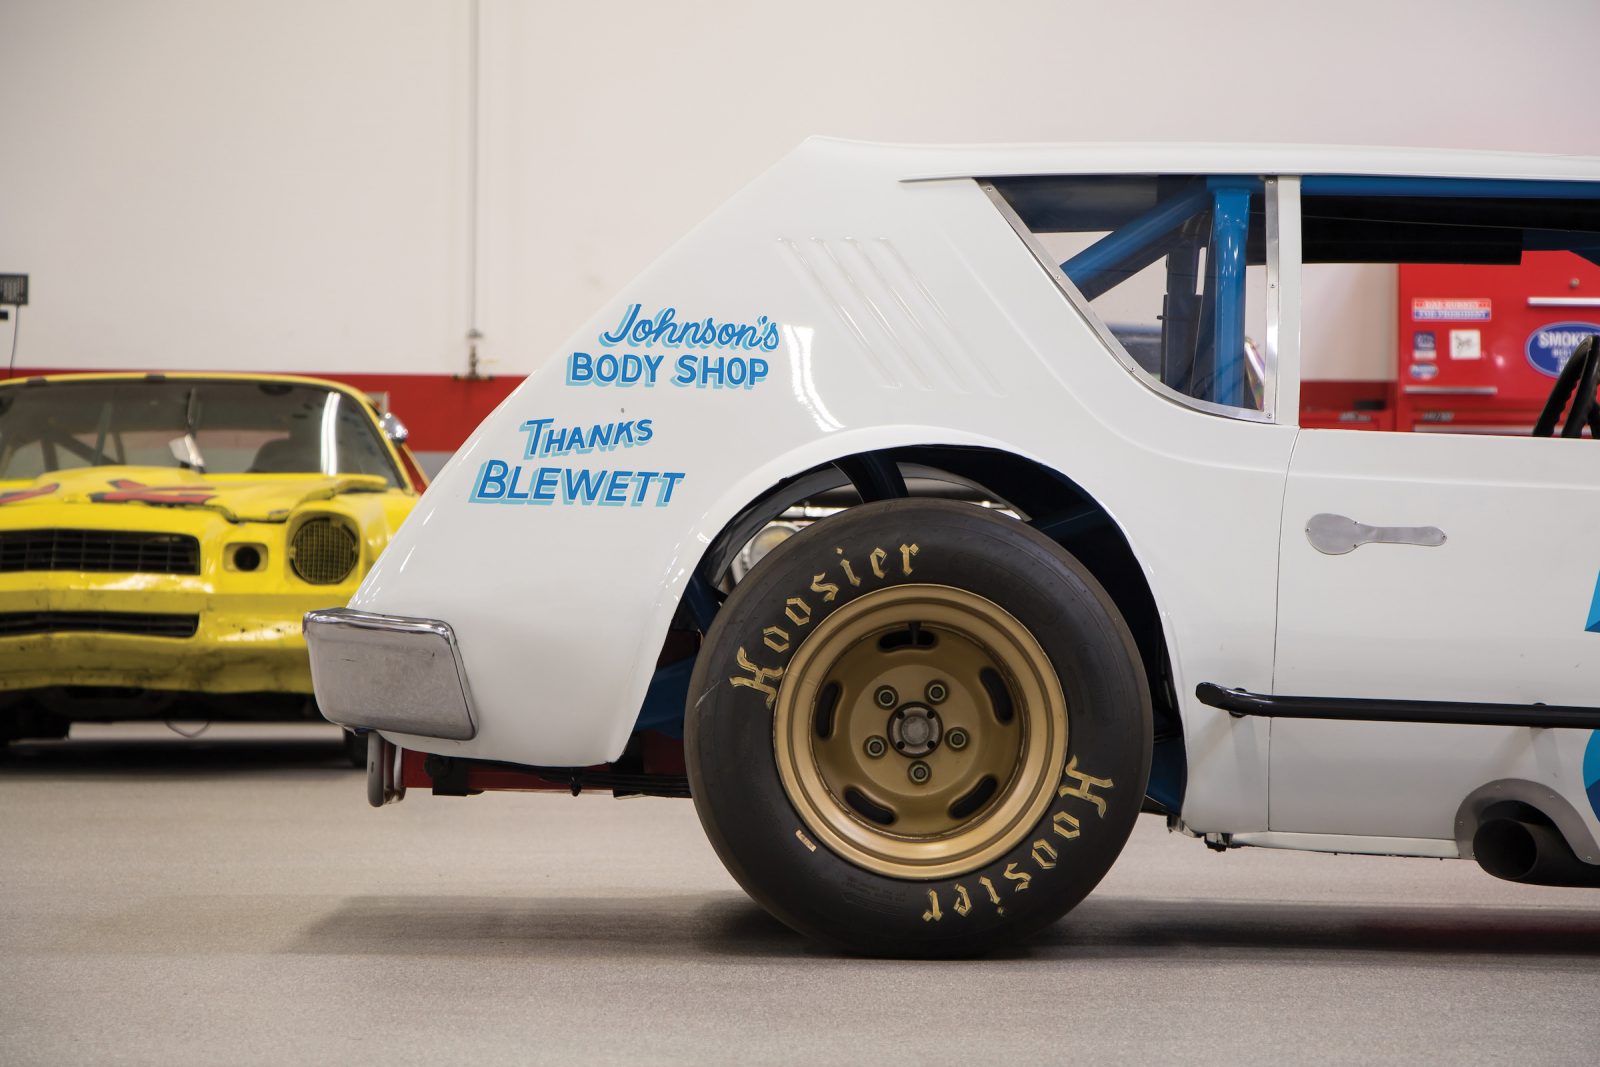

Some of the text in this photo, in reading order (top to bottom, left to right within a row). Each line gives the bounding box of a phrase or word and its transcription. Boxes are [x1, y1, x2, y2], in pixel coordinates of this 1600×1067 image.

[599, 304, 779, 351] Johnson's
[566, 352, 769, 389] BODY SHOP
[519, 418, 653, 459] THANKS
[468, 459, 685, 507] BLEWETT
[729, 544, 919, 709] Hoosier
[922, 755, 1114, 922] Hoosier
